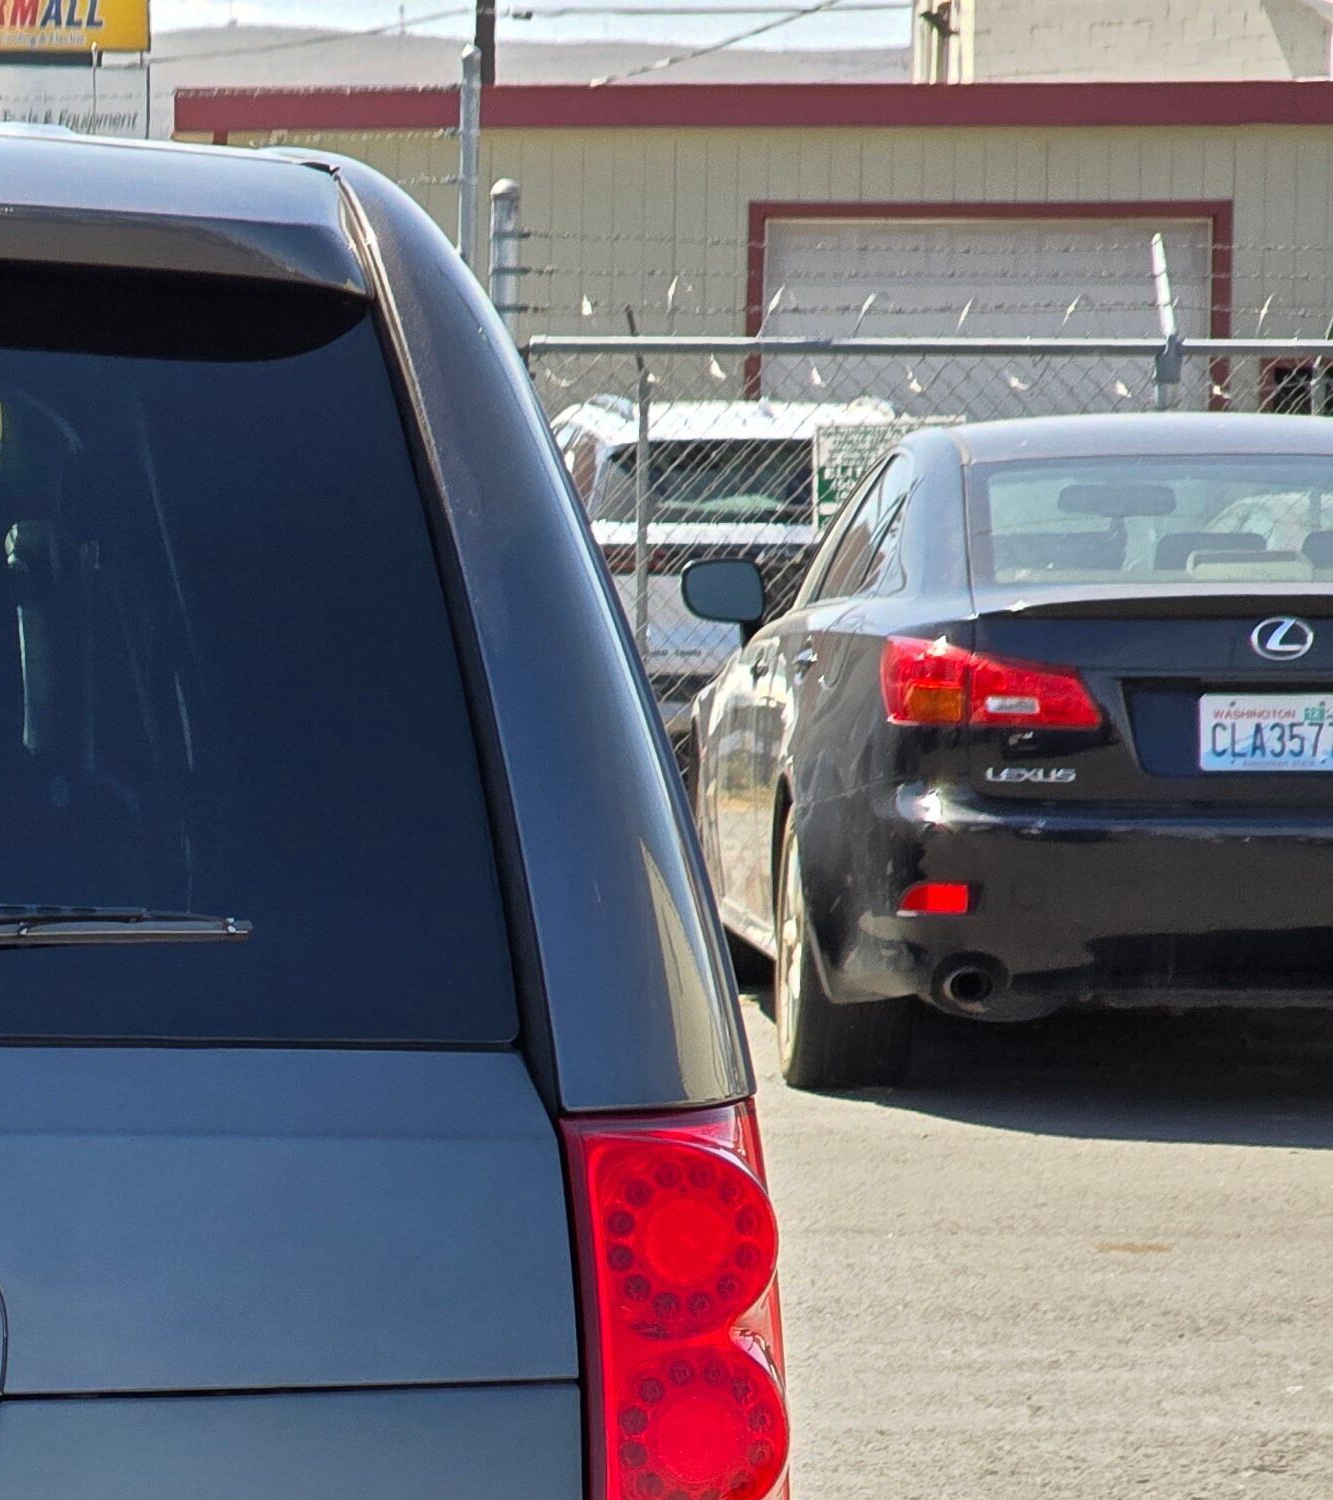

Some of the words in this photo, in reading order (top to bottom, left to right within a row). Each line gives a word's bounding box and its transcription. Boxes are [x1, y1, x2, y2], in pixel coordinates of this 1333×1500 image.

[1214, 709, 1296, 719] WASHINGTON
[1211, 722, 1333, 757] CLA357
[986, 767, 1077, 782] LEXUS
